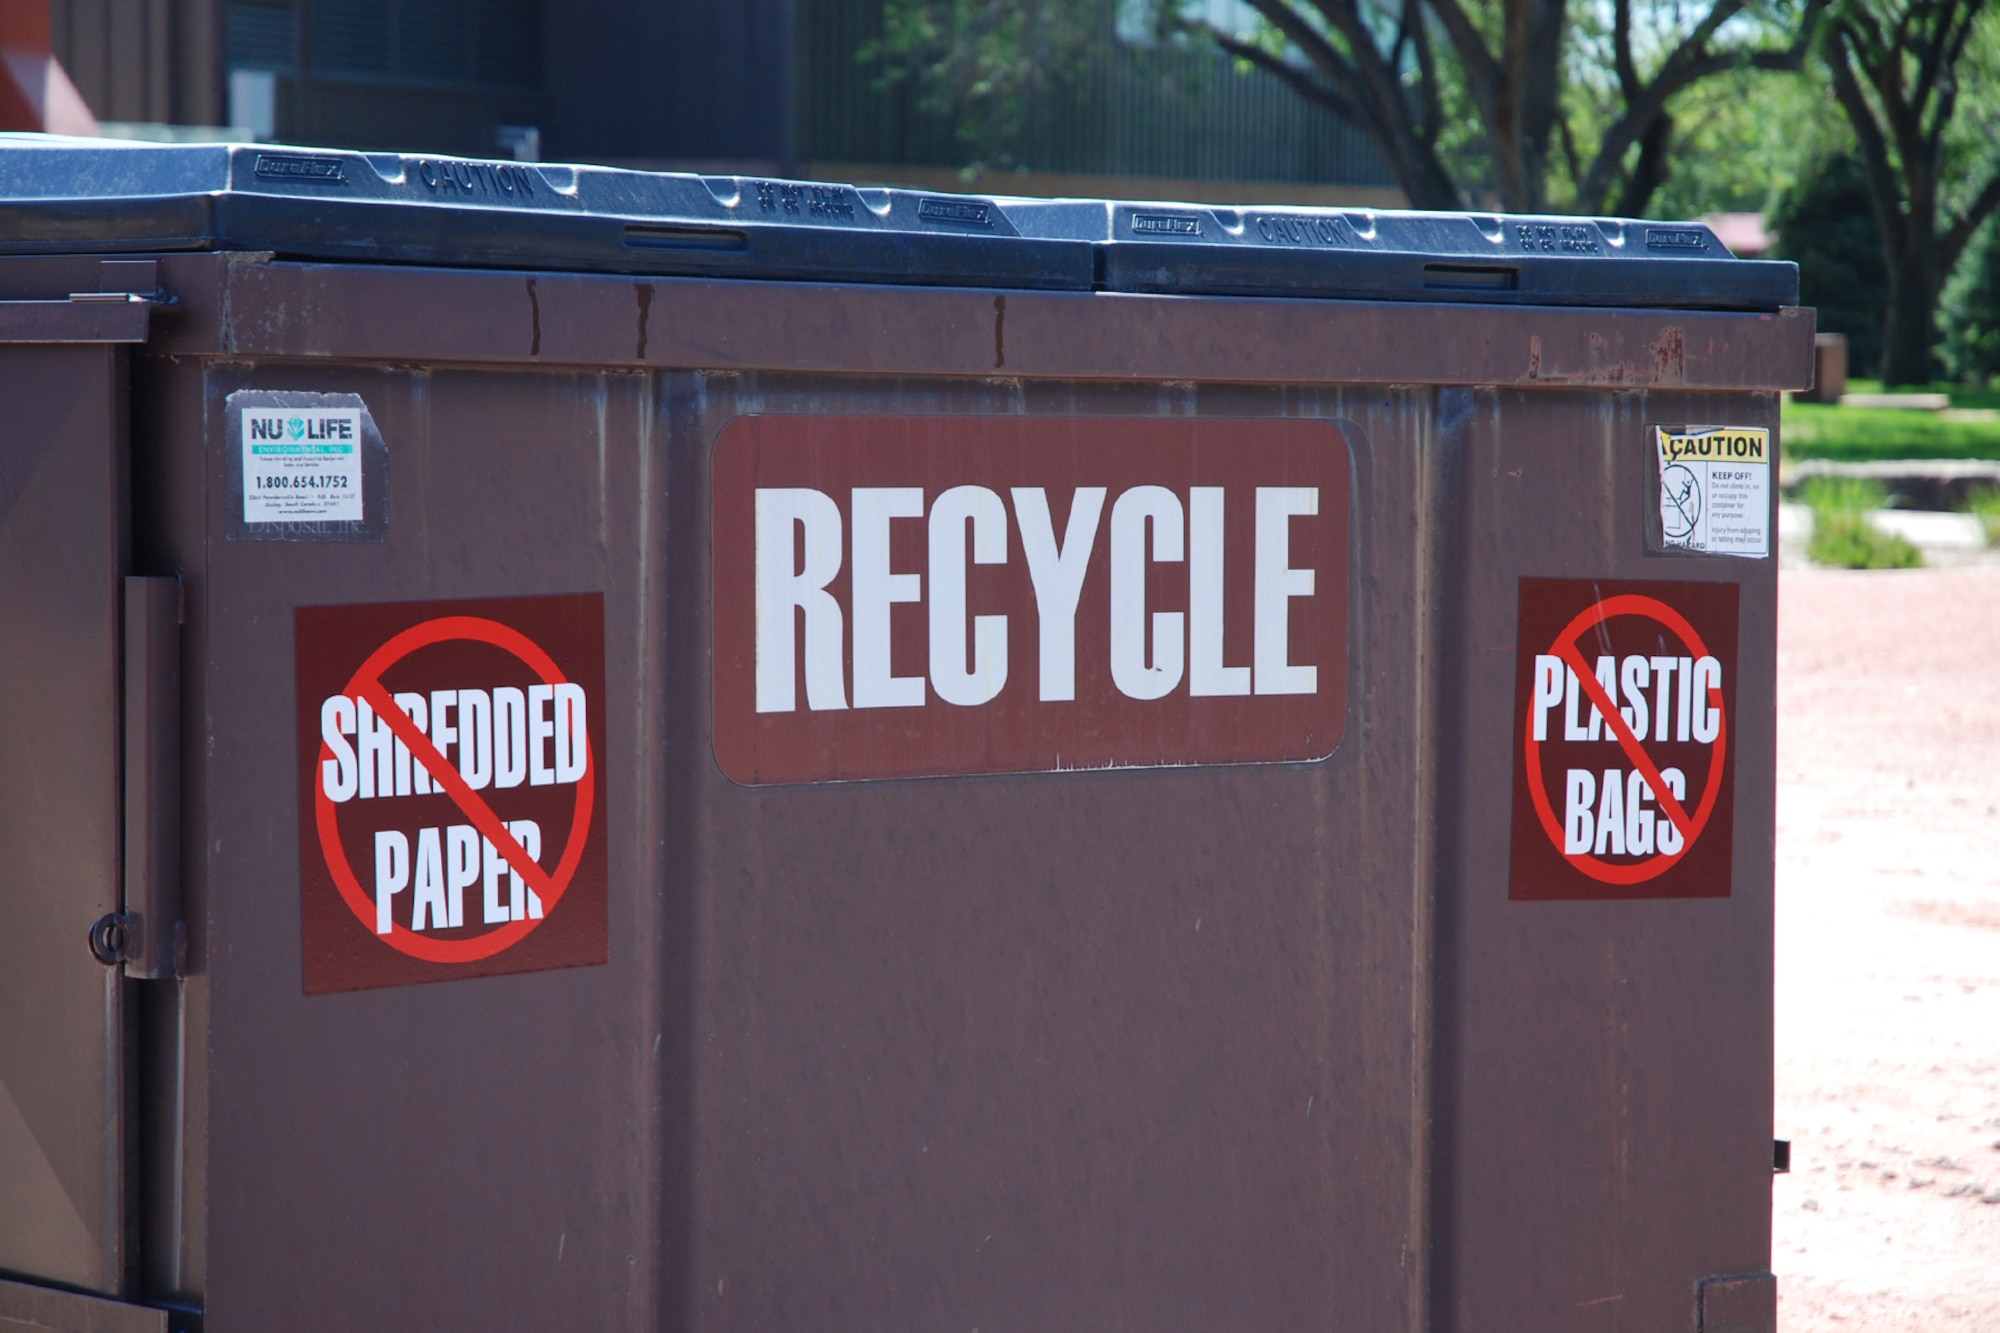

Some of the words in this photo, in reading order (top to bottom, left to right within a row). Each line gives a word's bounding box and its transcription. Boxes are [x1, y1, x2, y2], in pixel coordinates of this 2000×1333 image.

[419, 160, 534, 196] CAUTION
[1256, 216, 1349, 245] CAUTION
[251, 418, 283, 440] NU
[308, 418, 353, 440] LIFE
[1669, 436, 1762, 458] CAUTION
[256, 475, 348, 489] 1.800.654.1752
[1711, 471, 1733, 480] KEEP
[1734, 472, 1752, 480] OFF!
[755, 484, 1320, 713] RECYCLE
[1532, 654, 1723, 744] PLASTIC
[321, 682, 588, 804] SHREDDED
[1564, 766, 1687, 857] BAGS
[374, 819, 545, 935] PAPER
